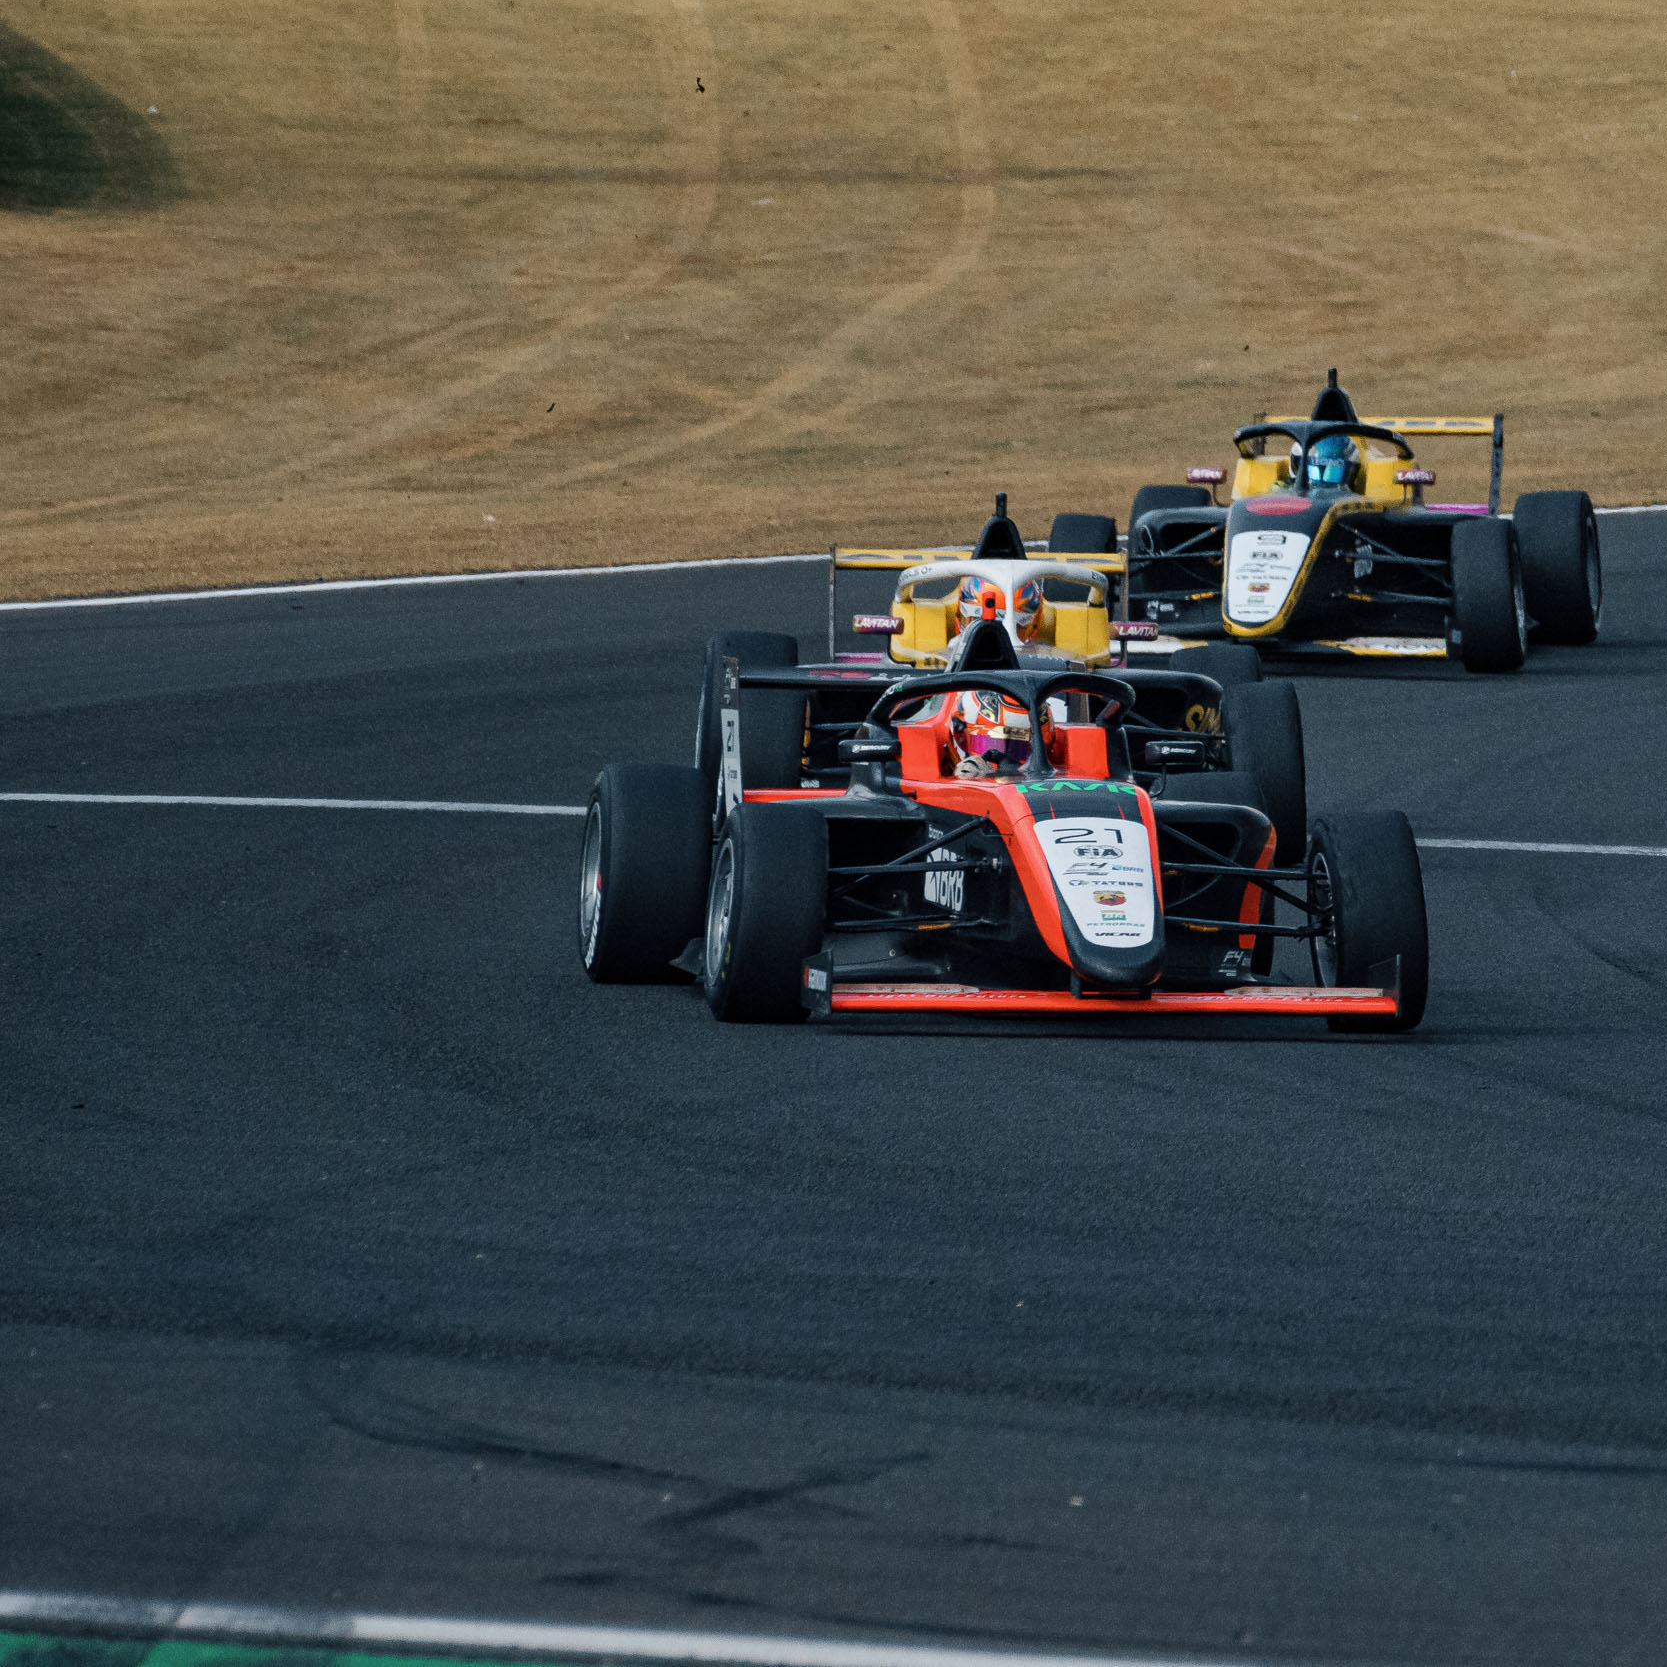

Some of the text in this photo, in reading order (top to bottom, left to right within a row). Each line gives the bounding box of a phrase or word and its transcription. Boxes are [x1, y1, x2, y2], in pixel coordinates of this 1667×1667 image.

[855, 617, 899, 628] LAVITAN
[1052, 827, 1124, 845] 21
[1066, 847, 1120, 857] FIA
